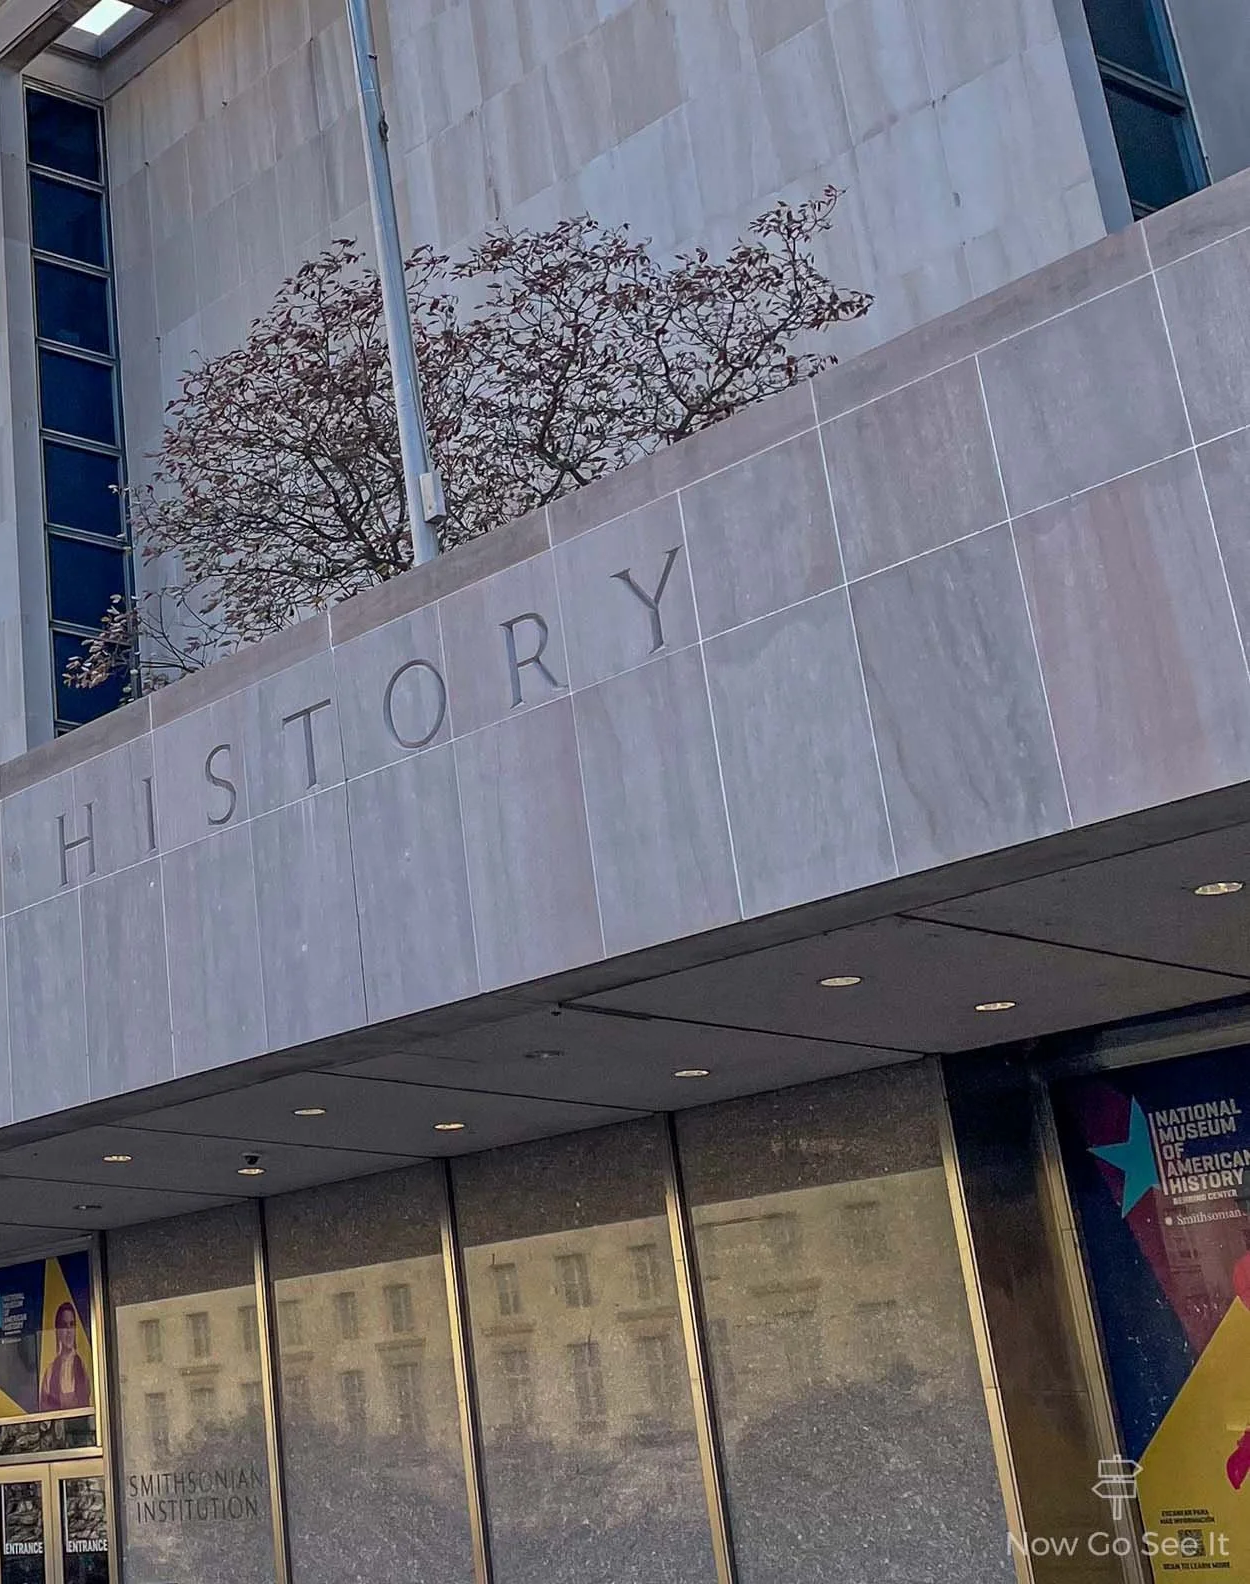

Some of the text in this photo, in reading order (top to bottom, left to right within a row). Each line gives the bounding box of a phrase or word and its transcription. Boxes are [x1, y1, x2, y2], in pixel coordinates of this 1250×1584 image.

[55, 543, 684, 888] HISTORY
[1155, 1098, 1242, 1127] NATIONAL
[1158, 1116, 1237, 1144] MUSEUM
[1162, 1142, 1185, 1161] OF
[1169, 1168, 1244, 1195] HISTORY
[1207, 1189, 1238, 1201] CENTER
[1176, 1208, 1242, 1226] Smithsonian
[128, 1466, 264, 1498] SMITHSONIAN
[136, 1493, 259, 1524] INSTITUTION
[3, 1542, 44, 1555] ENTRANCE
[67, 1539, 108, 1553] ENTRANCE
